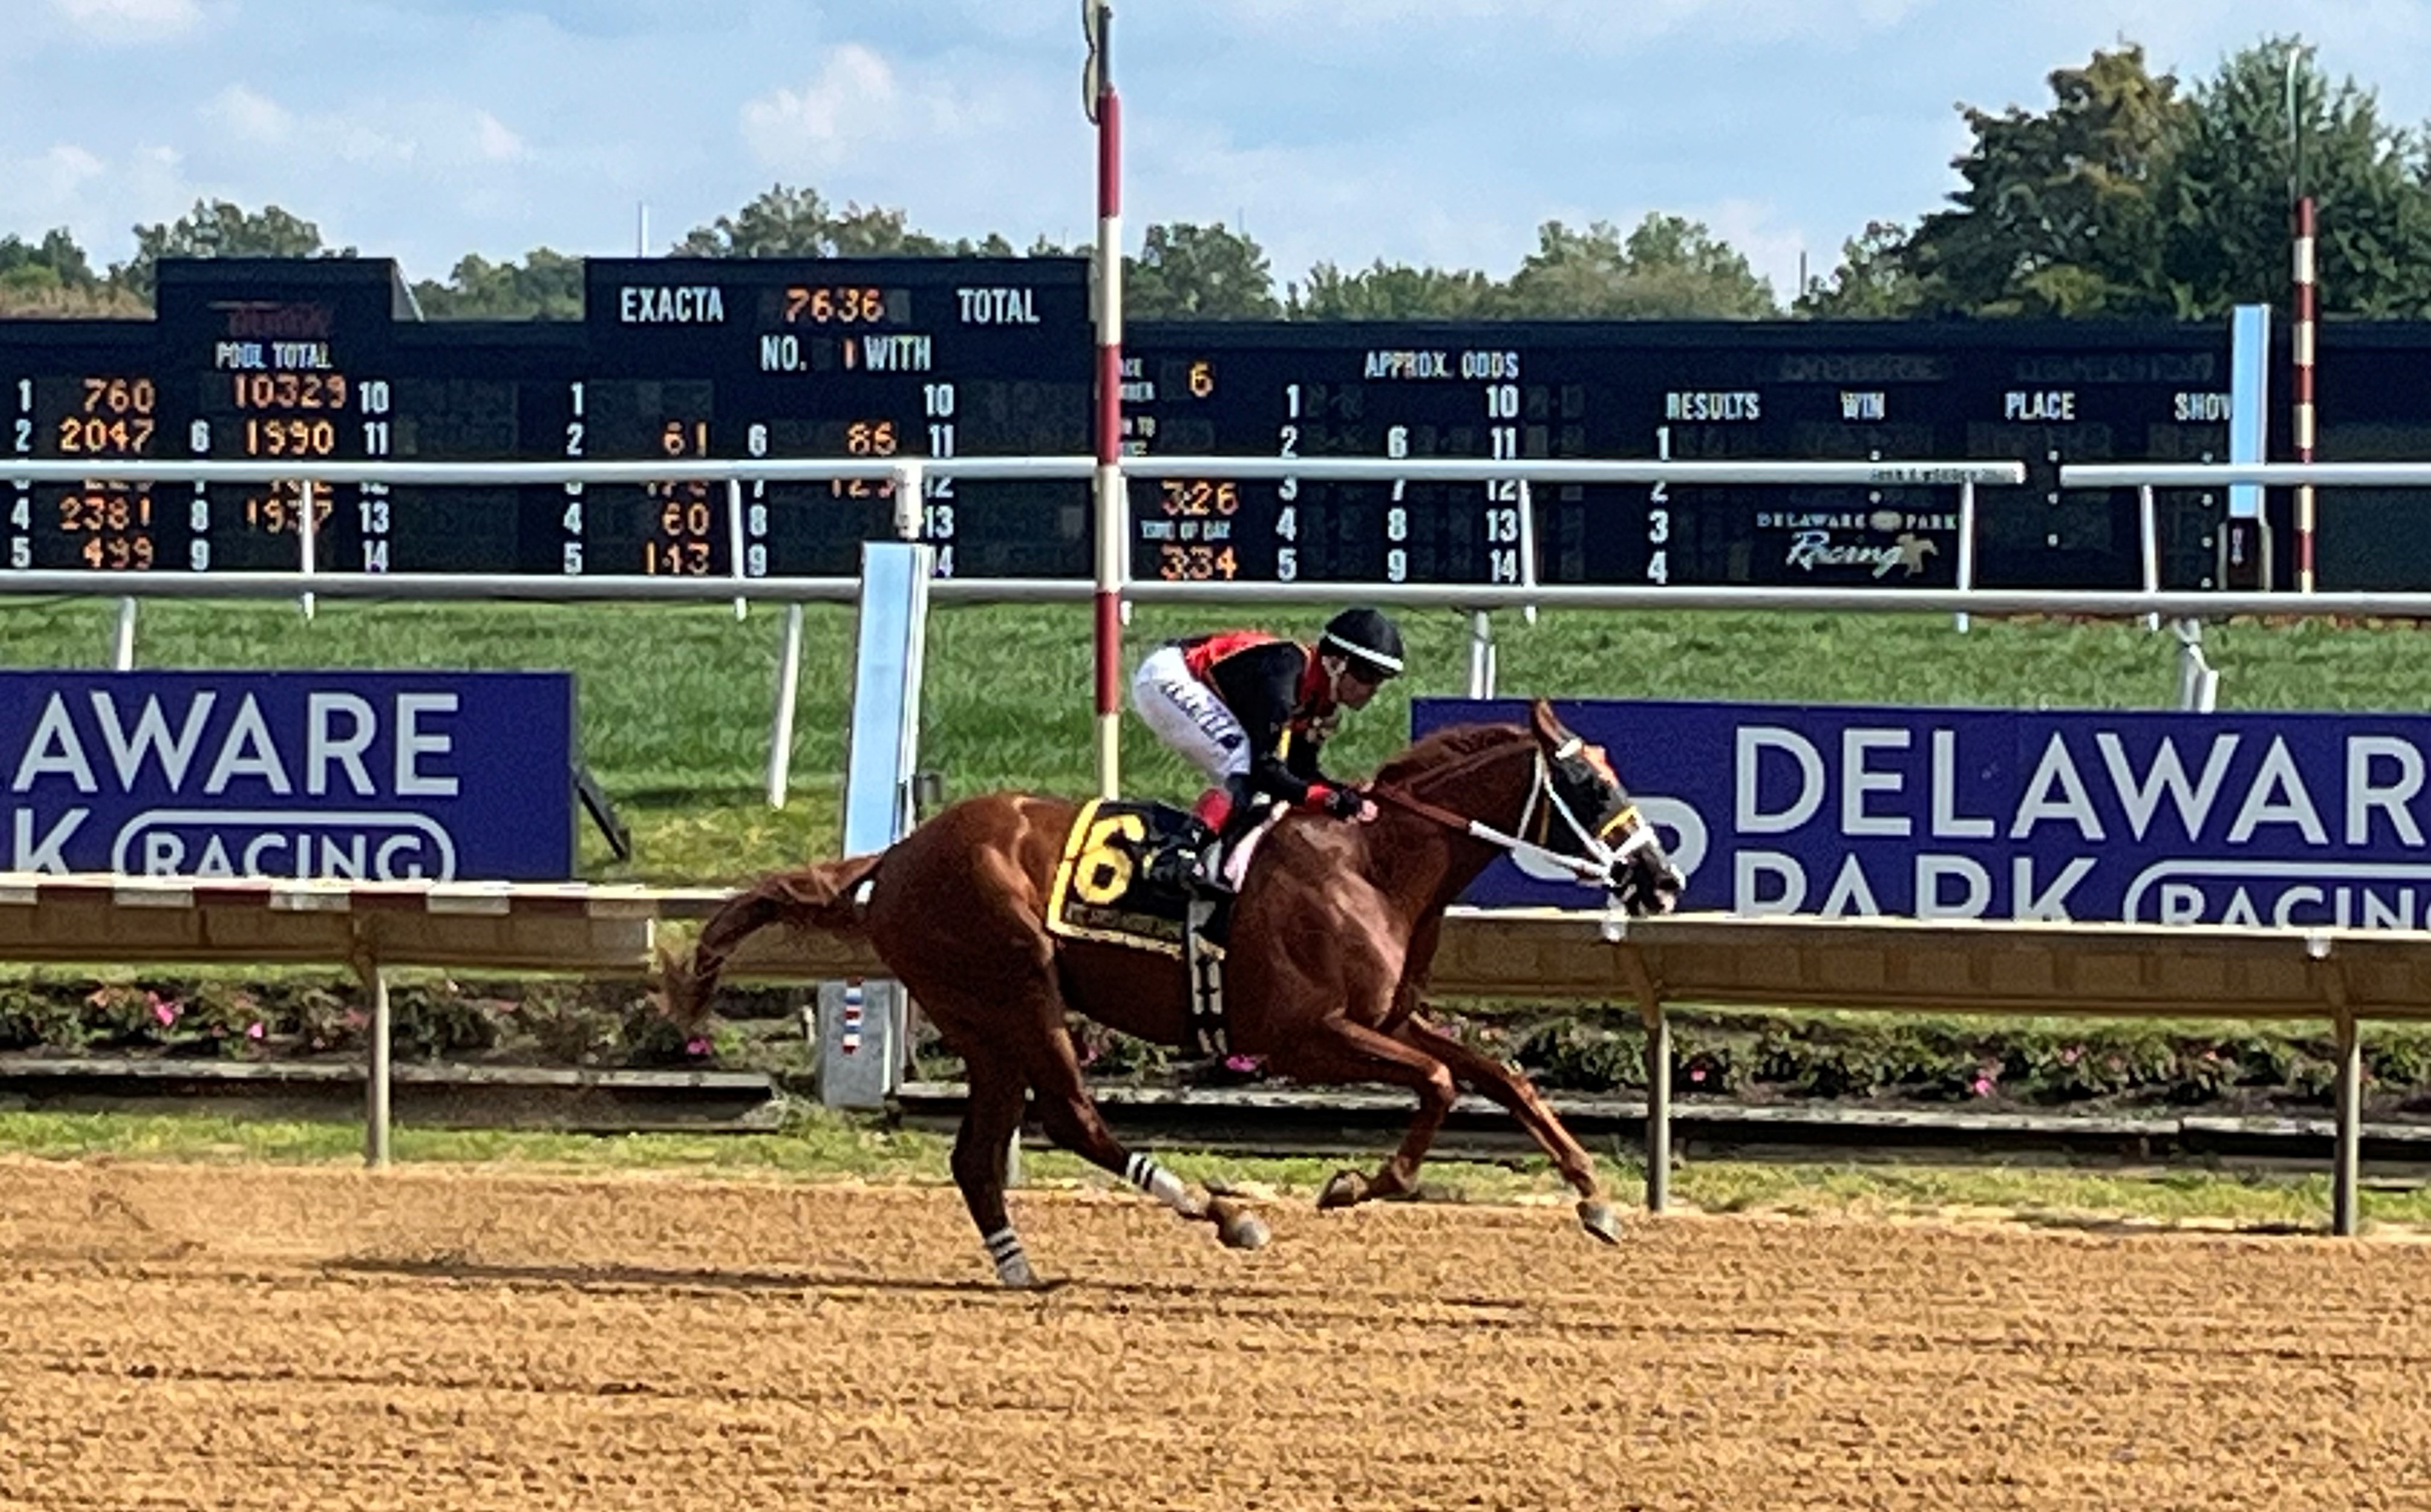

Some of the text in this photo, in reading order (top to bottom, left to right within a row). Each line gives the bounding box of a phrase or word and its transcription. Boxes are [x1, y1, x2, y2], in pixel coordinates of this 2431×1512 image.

[621, 286, 1041, 323] EXACTA 7636 TOTAL
[215, 341, 333, 370] POOL TOTAL
[761, 335, 931, 372] NO. 1 WITH
[1364, 350, 1520, 379] APPROX. ODDS
[235, 373, 347, 408] 10329
[1189, 360, 1214, 397] 6
[17, 378, 156, 414] 1 760
[359, 381, 390, 414] 10
[571, 381, 584, 416] 1
[924, 384, 954, 416] 10
[1286, 384, 1299, 419] 1
[1486, 384, 1520, 419] 10
[1665, 392, 1760, 420] RESULTS
[1840, 390, 1885, 420] WIN
[2005, 390, 2076, 421] PLACE
[15, 417, 155, 452] 2 2047
[190, 419, 335, 455] 6 1990
[363, 421, 389, 455] 11
[566, 421, 708, 457] 2 61
[748, 424, 767, 457] 6
[928, 424, 954, 458] 11
[1280, 425, 1299, 458] 2
[1387, 425, 1409, 458] 6
[1491, 426, 1517, 460] 11
[1656, 425, 1670, 461] 1
[1486, 479, 1517, 502] 12
[11, 496, 150, 530] 4 2381
[190, 499, 209, 532] 8
[358, 501, 389, 533] 13
[563, 502, 582, 535] 4
[749, 504, 767, 537] 8
[924, 505, 954, 538] 13
[1275, 506, 1296, 541] 4
[1387, 507, 1407, 542] 8
[1486, 508, 1518, 542] 13
[1649, 510, 1669, 543] 3
[1757, 511, 1957, 530] DELAWARE PARK
[11, 536, 31, 568] 5
[190, 538, 209, 571] 9
[363, 540, 389, 572] 14
[563, 542, 583, 575] 5
[748, 543, 767, 577] 9
[1278, 546, 1296, 582] 5
[1387, 548, 1408, 583] 9
[1489, 548, 1517, 583] 14
[1647, 549, 1667, 585] 4
[1786, 529, 1904, 578] Racing
[11, 691, 458, 796] AWARE
[1736, 726, 2426, 846] DELAWAR
[144, 832, 424, 881] RACING
[1074, 814, 1145, 905] 6
[2160, 883, 2431, 930] RACIN
